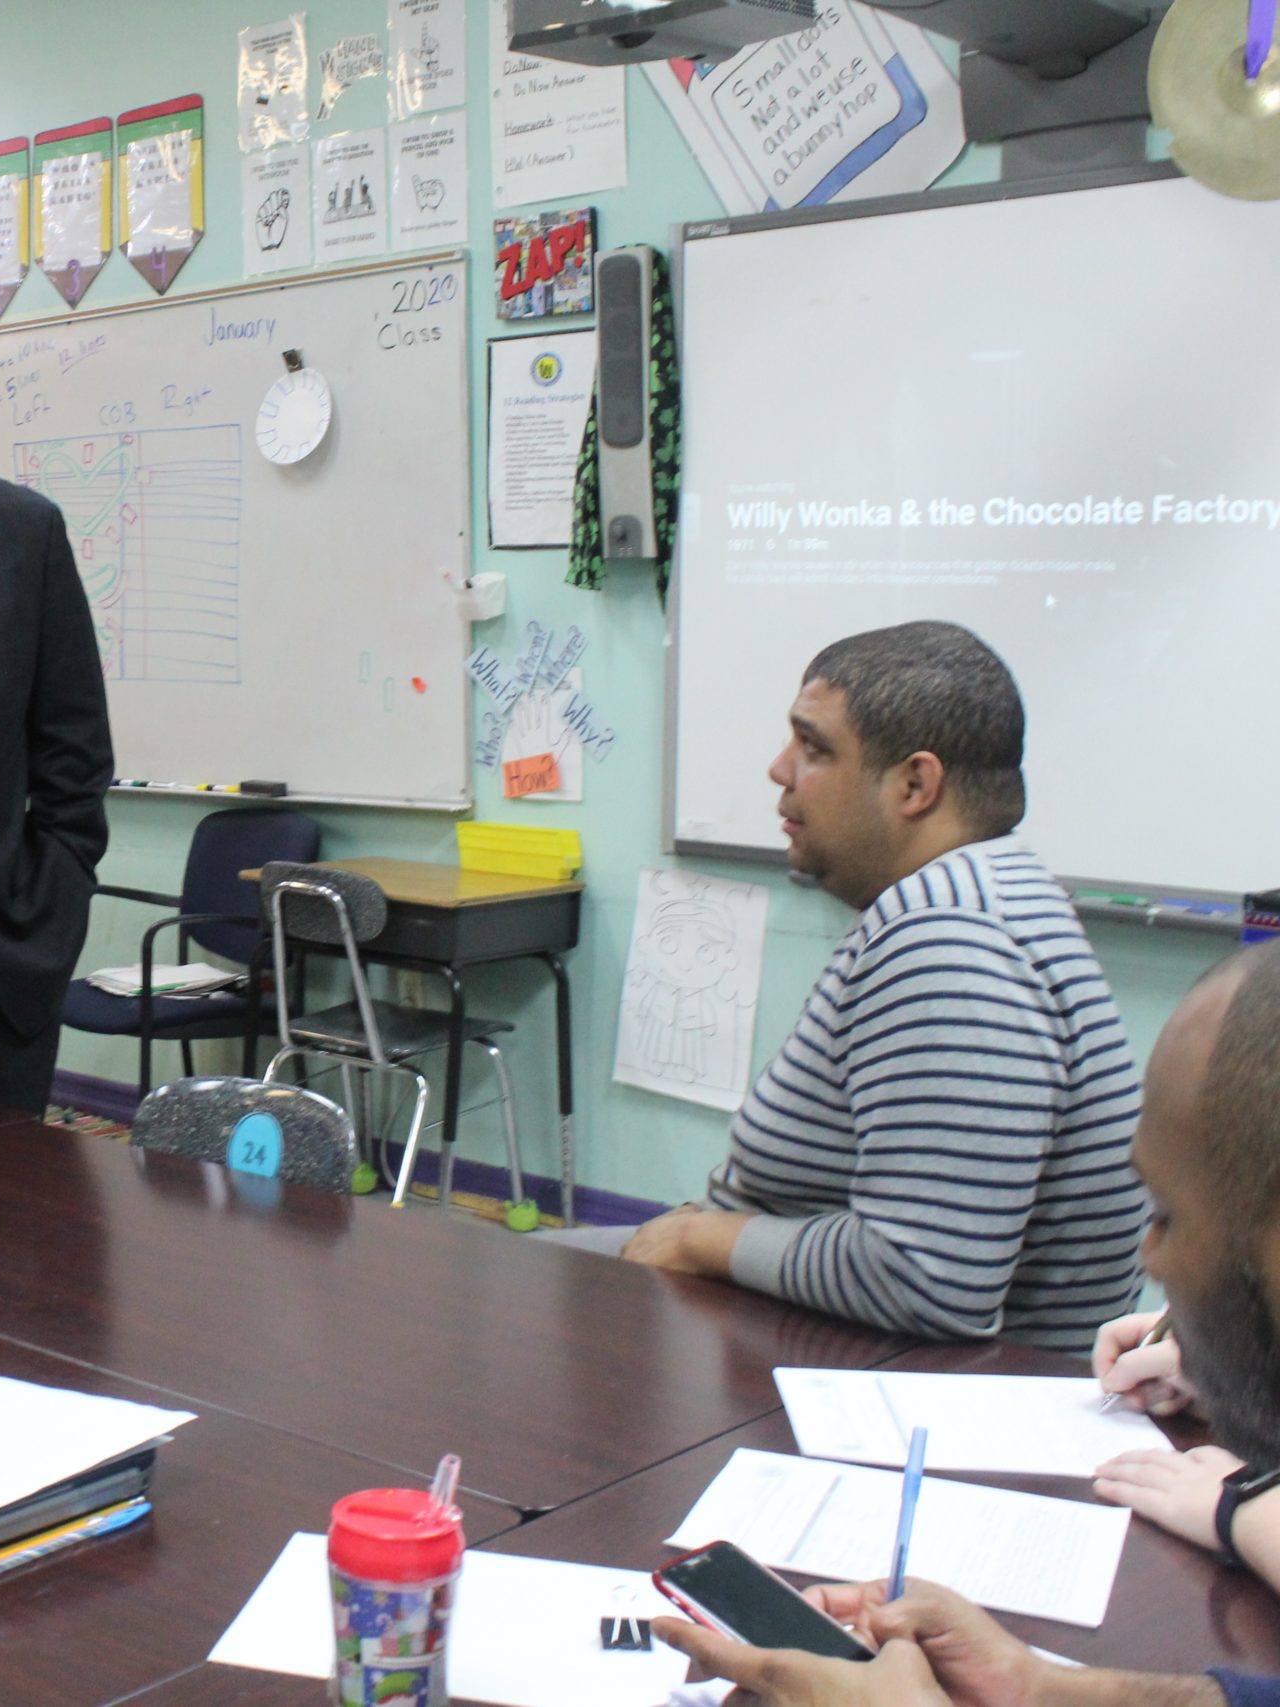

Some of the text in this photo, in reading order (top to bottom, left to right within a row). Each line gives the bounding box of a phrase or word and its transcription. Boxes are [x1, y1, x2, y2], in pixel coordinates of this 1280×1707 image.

[732, 36, 798, 109] Small
[750, 49, 831, 132] Not a lot
[763, 105, 802, 155] and
[772, 81, 877, 187] a bunny hop
[66, 259, 80, 296] 3
[151, 245, 167, 289] 4
[497, 220, 586, 300] ZAP!
[391, 274, 458, 314] 2020
[203, 308, 277, 346] January
[377, 323, 443, 350] Class
[6, 376, 17, 400] 5
[727, 494, 1280, 534] Willy Wonka & the Chocolate Factory
[471, 647, 521, 703] What?
[517, 620, 548, 685] When?
[475, 711, 502, 768] Who?
[563, 693, 615, 748] Why?
[508, 755, 556, 792] How?
[242, 1140, 267, 1167] 24
